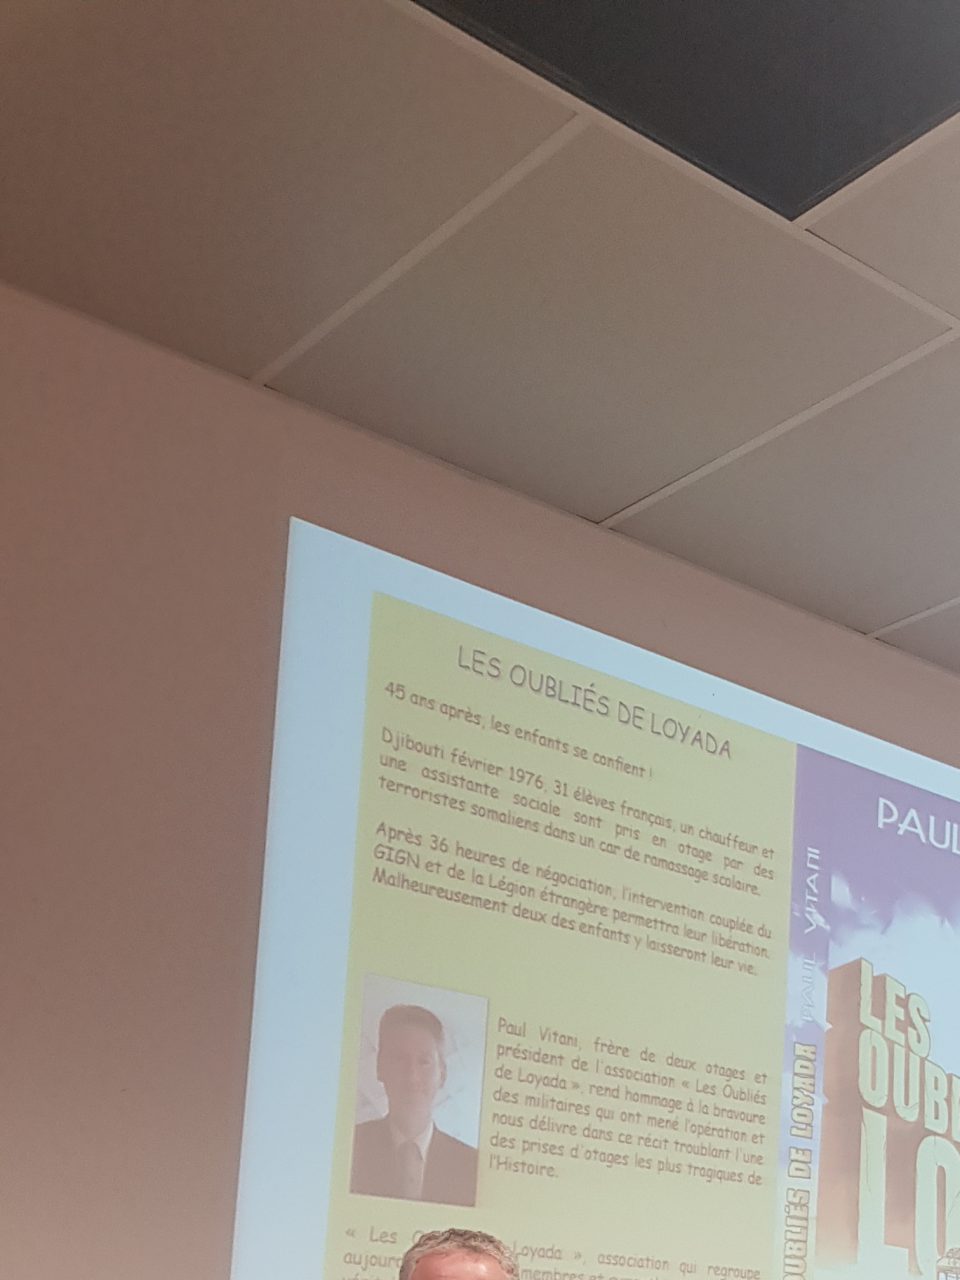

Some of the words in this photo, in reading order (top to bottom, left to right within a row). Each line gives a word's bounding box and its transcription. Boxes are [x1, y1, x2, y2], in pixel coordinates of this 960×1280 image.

[384, 681, 406, 701] 45
[409, 692, 436, 710] ans
[490, 714, 511, 735] les
[513, 727, 569, 754] enfants
[572, 745, 588, 760] se
[592, 752, 646, 777] confient
[457, 644, 501, 680] LES
[509, 663, 610, 717] OUBLIÉS
[617, 700, 645, 730] DE
[650, 712, 730, 759] LOYADA
[378, 774, 466, 812] terroristes
[469, 802, 540, 832] somaliens
[542, 820, 576, 843] dans
[578, 834, 595, 848] un
[598, 840, 621, 855] car
[623, 844, 640, 861] de
[642, 852, 709, 883] ramassage
[379, 754, 407, 772] une
[420, 766, 500, 799] assistante
[512, 792, 560, 817] sociale
[572, 810, 603, 828] sont
[614, 822, 640, 840] pris
[650, 834, 666, 848] en
[676, 842, 712, 864] otage
[722, 855, 744, 870] par
[752, 862, 774, 880] des
[381, 725, 444, 759] Djibouti
[449, 747, 504, 777] février
[552, 778, 568, 797] 31
[572, 785, 616, 812] élèves
[679, 823, 694, 836] un
[698, 826, 758, 854] chauffeur
[761, 847, 774, 860] et
[371, 866, 509, 914] Malheureusement
[510, 901, 547, 924] deux
[550, 911, 576, 931] des
[577, 920, 631, 944] enfants
[634, 933, 642, 950] y
[645, 933, 707, 962] laisseront
[710, 950, 734, 969] leur
[373, 842, 420, 869] GIGN
[424, 860, 443, 874] et
[445, 862, 466, 881] de
[470, 866, 485, 885] la
[487, 872, 536, 898] Légion
[538, 885, 609, 917] étrangère
[611, 908, 680, 935] permettra
[682, 922, 707, 942] leur
[375, 821, 422, 847] Après
[428, 833, 449, 854] 36
[454, 840, 506, 868] heures
[511, 856, 530, 875] de
[708, 913, 754, 934] couplée
[756, 923, 771, 939] du
[804, 847, 820, 935] VITANI
[497, 1016, 526, 1038] Paul
[592, 1036, 630, 1058] frère
[639, 1046, 656, 1063] de
[665, 1051, 696, 1071] deux
[705, 1062, 746, 1082] otages
[753, 1072, 768, 1084] et
[858, 957, 931, 1058] LES
[492, 1084, 519, 1104] des
[524, 1092, 591, 1116] militaires
[594, 1106, 615, 1122] qui
[618, 1110, 642, 1124] ont
[646, 1115, 679, 1131] mené
[750, 1132, 765, 1144] et
[493, 1062, 513, 1080] de
[517, 1066, 567, 1090] Loyada
[588, 1083, 620, 1099] rend
[624, 1084, 682, 1114] hommage
[685, 1097, 694, 1112] à
[697, 1098, 709, 1115] la
[712, 1102, 766, 1125] bravoure
[495, 1042, 565, 1066] président
[570, 1054, 589, 1072] de
[695, 1078, 717, 1096] Les
[721, 1083, 767, 1105] Oubliés
[790, 1042, 817, 1139] LOYADA
[488, 1130, 516, 1150] des
[521, 1138, 565, 1156] prises
[634, 1151, 653, 1170] les
[656, 1156, 682, 1174] plus
[685, 1162, 744, 1184] tragiques
[746, 1169, 762, 1186] de
[491, 1111, 524, 1128] nous
[528, 1113, 577, 1136] délivre
[581, 1122, 613, 1141] dans
[617, 1132, 633, 1144] ce
[636, 1132, 669, 1150] récit
[672, 1138, 732, 1160] troublant
[788, 1145, 812, 1180] DE
[596, 1252, 670, 1270] association
[678, 1261, 696, 1277] qui
